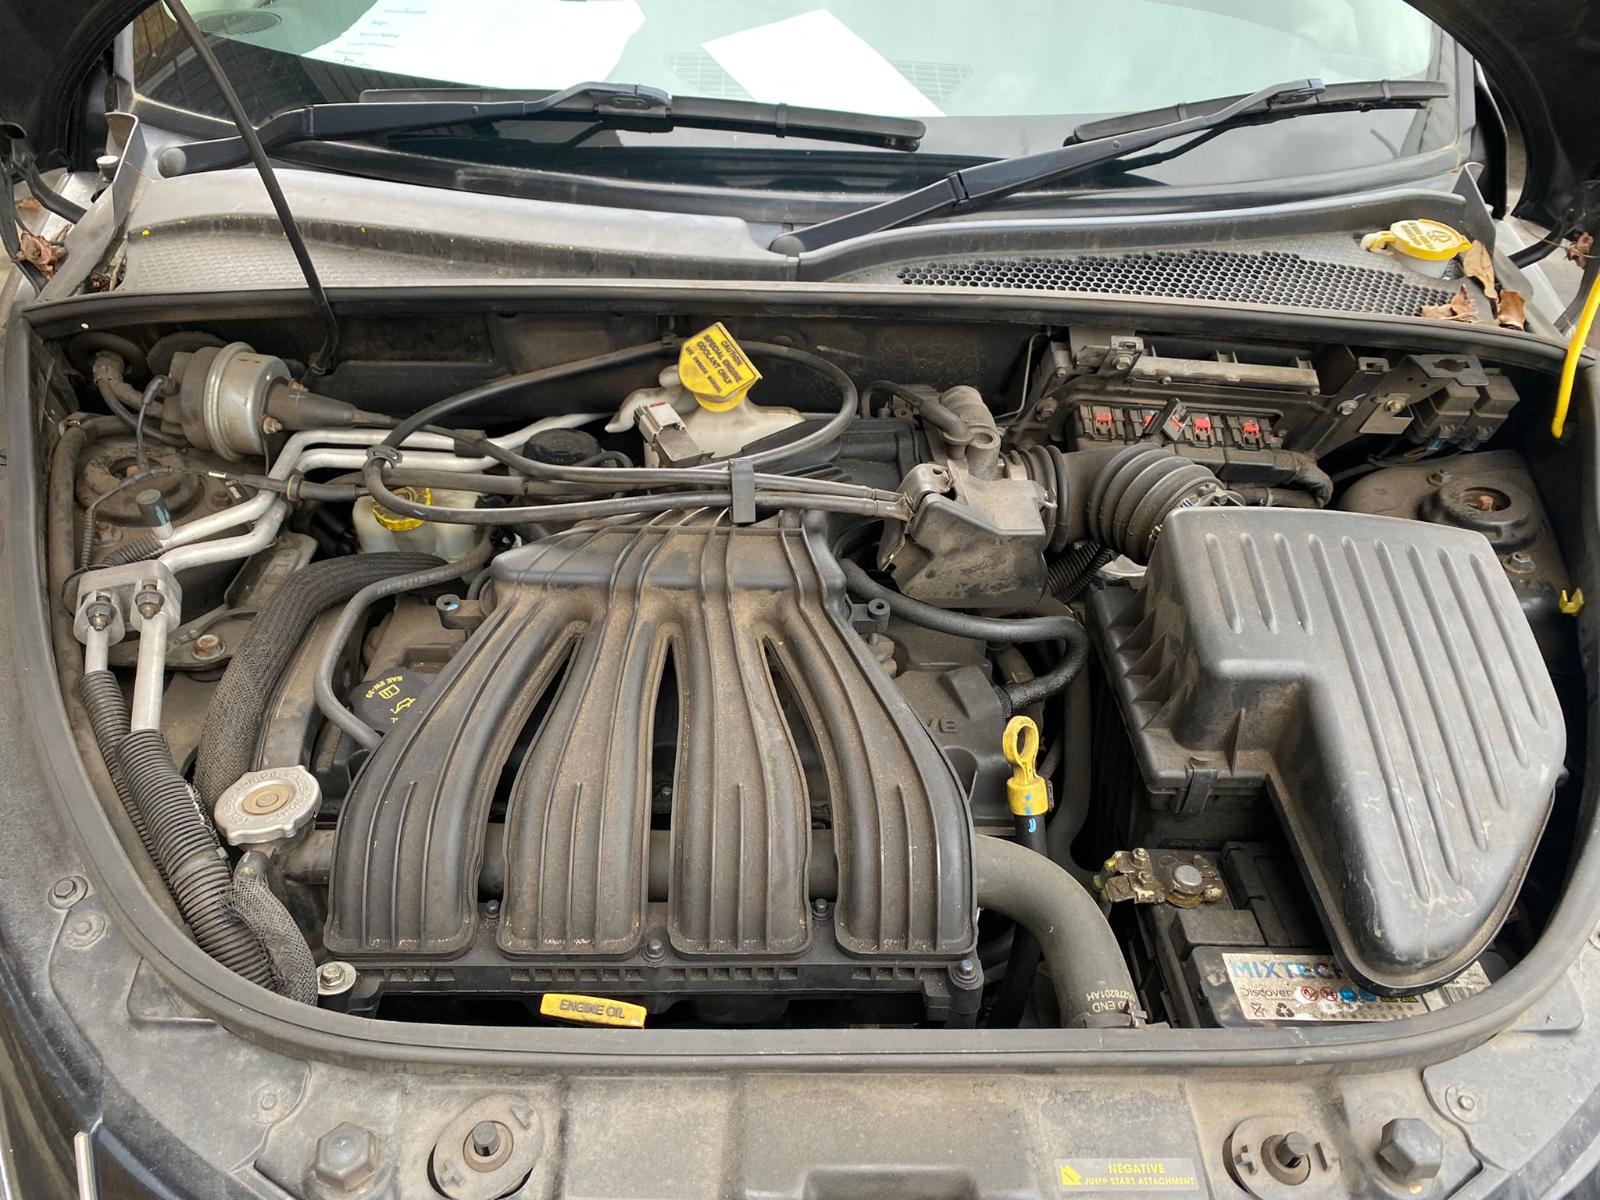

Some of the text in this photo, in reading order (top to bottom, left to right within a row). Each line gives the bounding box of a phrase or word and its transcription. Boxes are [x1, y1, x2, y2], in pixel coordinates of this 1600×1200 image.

[704, 334, 724, 360] SPECIAL
[721, 340, 743, 366] CAUTION
[697, 341, 732, 384] COOLANT ONLY
[386, 675, 403, 684] SAE
[1239, 986, 1291, 997] Discover
[560, 999, 625, 1019] ENGINE OIL
[1092, 1000, 1115, 1013] END
[1108, 1163, 1165, 1174] NEGATIVE
[1084, 1176, 1195, 1185] JUMP START ATTACHMENT
